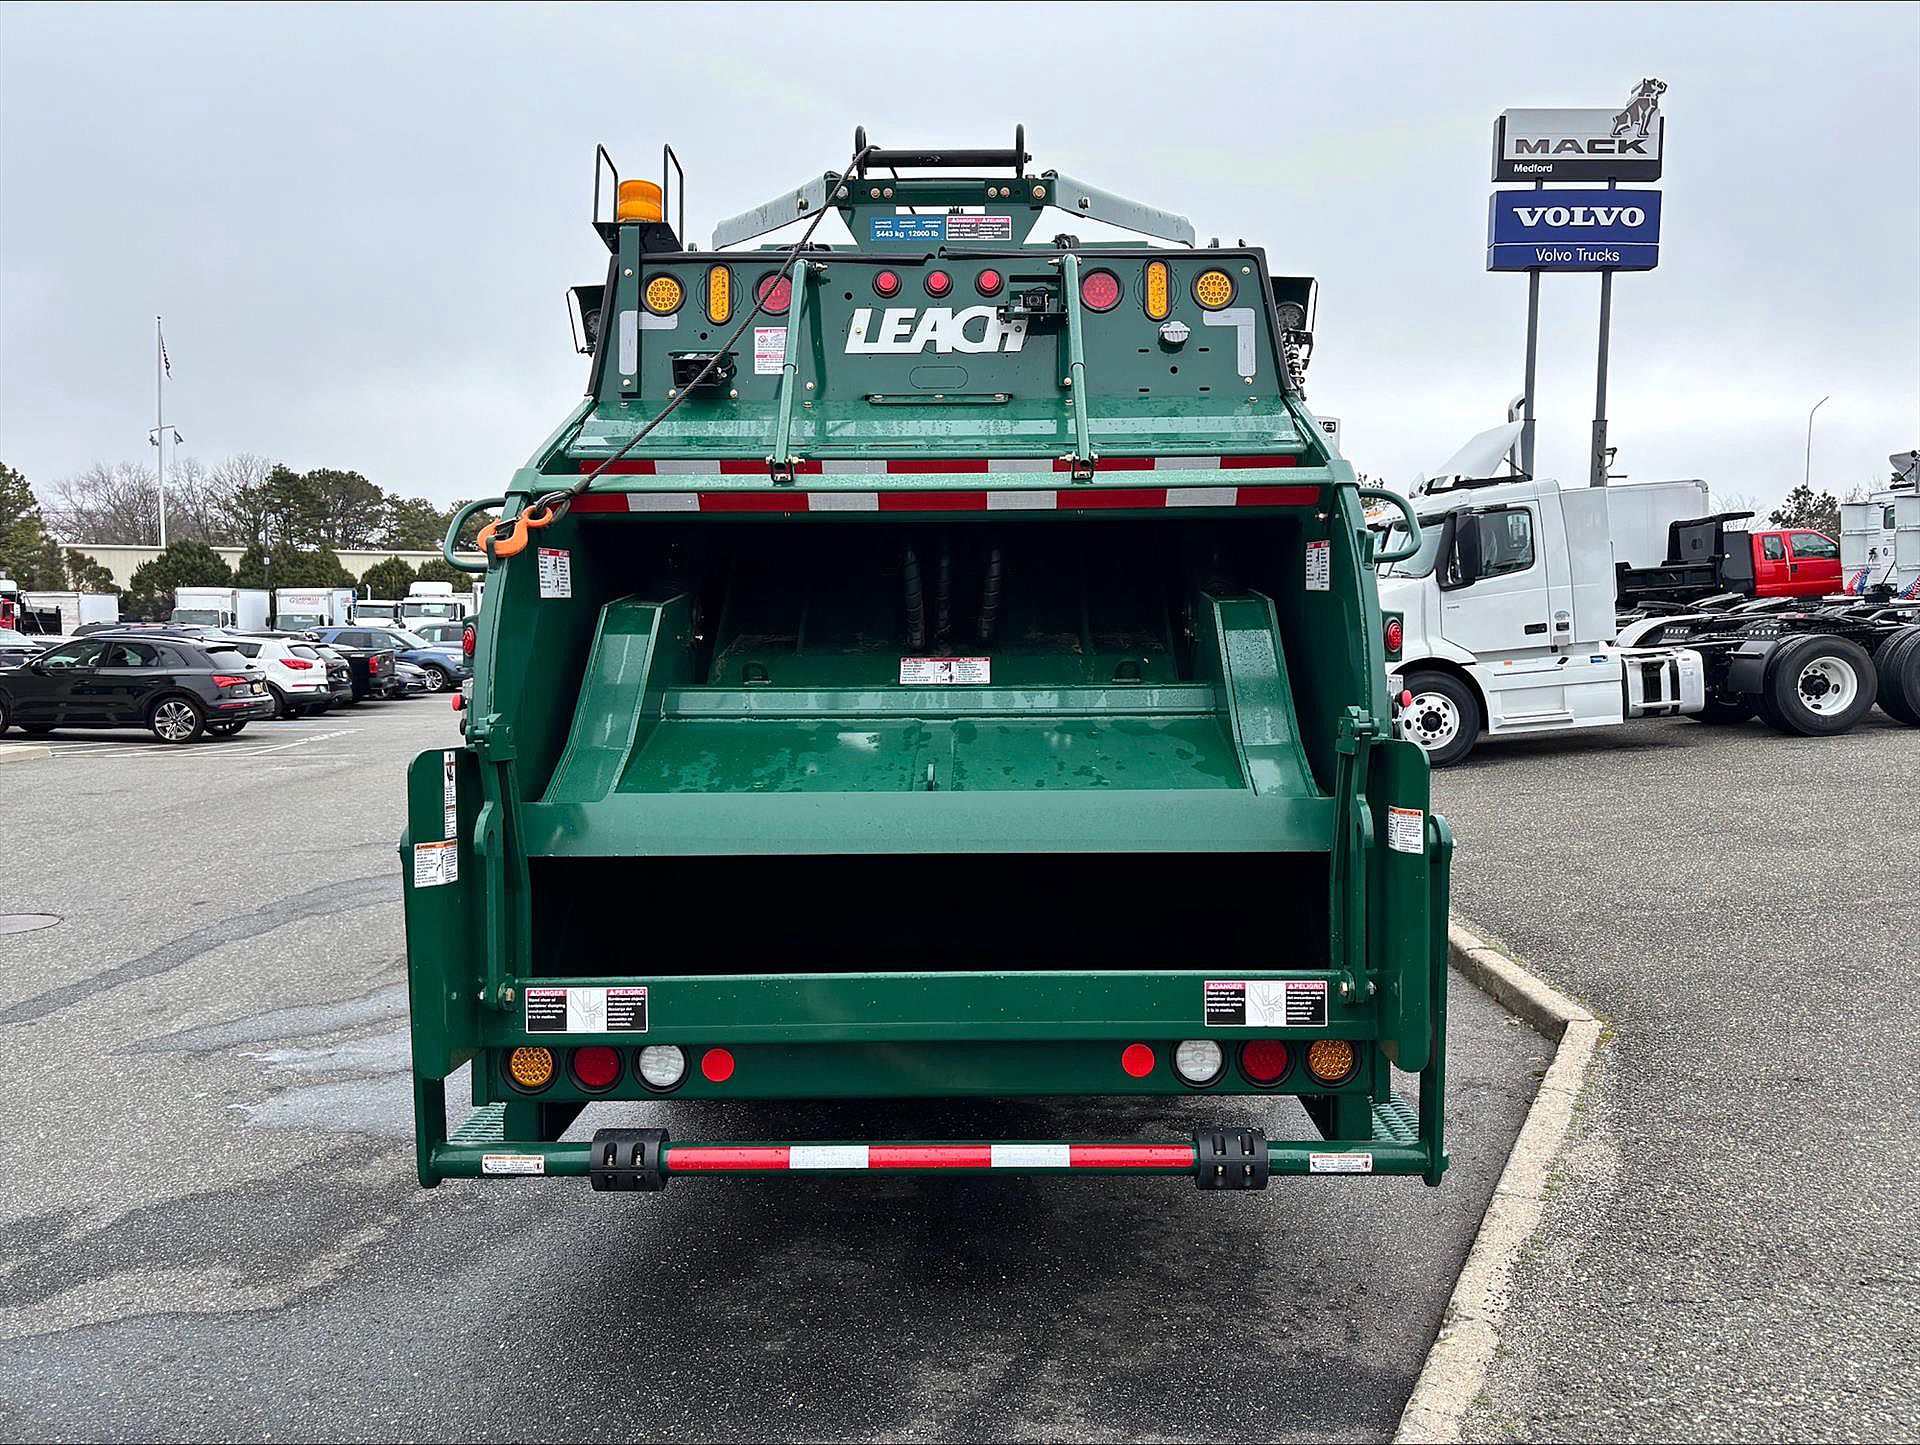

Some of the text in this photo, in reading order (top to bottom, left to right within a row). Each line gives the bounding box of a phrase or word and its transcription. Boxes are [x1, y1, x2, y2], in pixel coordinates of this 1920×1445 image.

[1515, 139, 1648, 154] MACK
[1513, 163, 1553, 173] Medford
[1513, 207, 1646, 227] VOLVO
[876, 230, 894, 238] 5443
[895, 230, 905, 239] kg
[1536, 248, 1620, 262] Volvo Trucks
